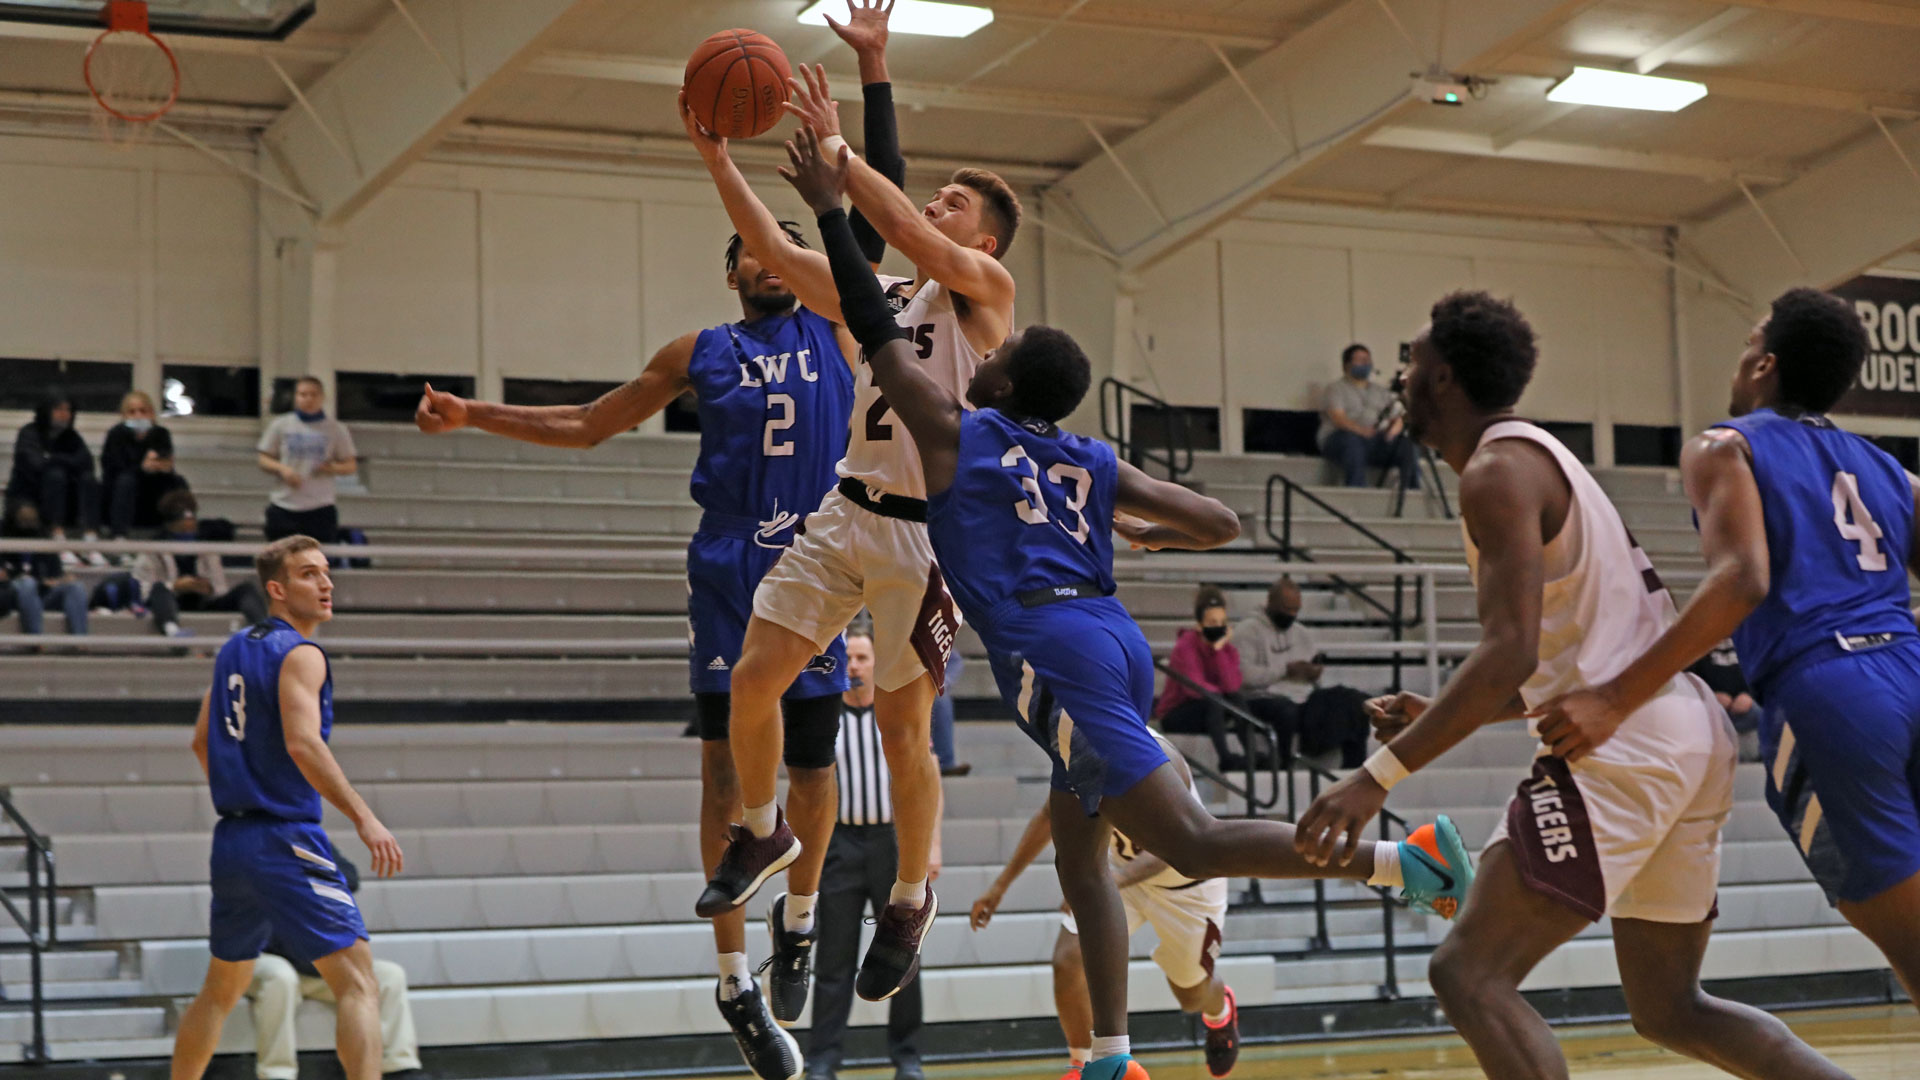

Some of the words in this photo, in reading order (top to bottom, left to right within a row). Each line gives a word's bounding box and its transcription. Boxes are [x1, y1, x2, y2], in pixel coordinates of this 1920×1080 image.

[740, 349, 818, 388] LWC
[763, 393, 795, 456] 2
[1001, 444, 1092, 545] 33
[1832, 471, 1888, 571] 4
[928, 609, 953, 670] TIGER
[225, 673, 247, 742] 3
[1530, 775, 1578, 863] TIGERS
